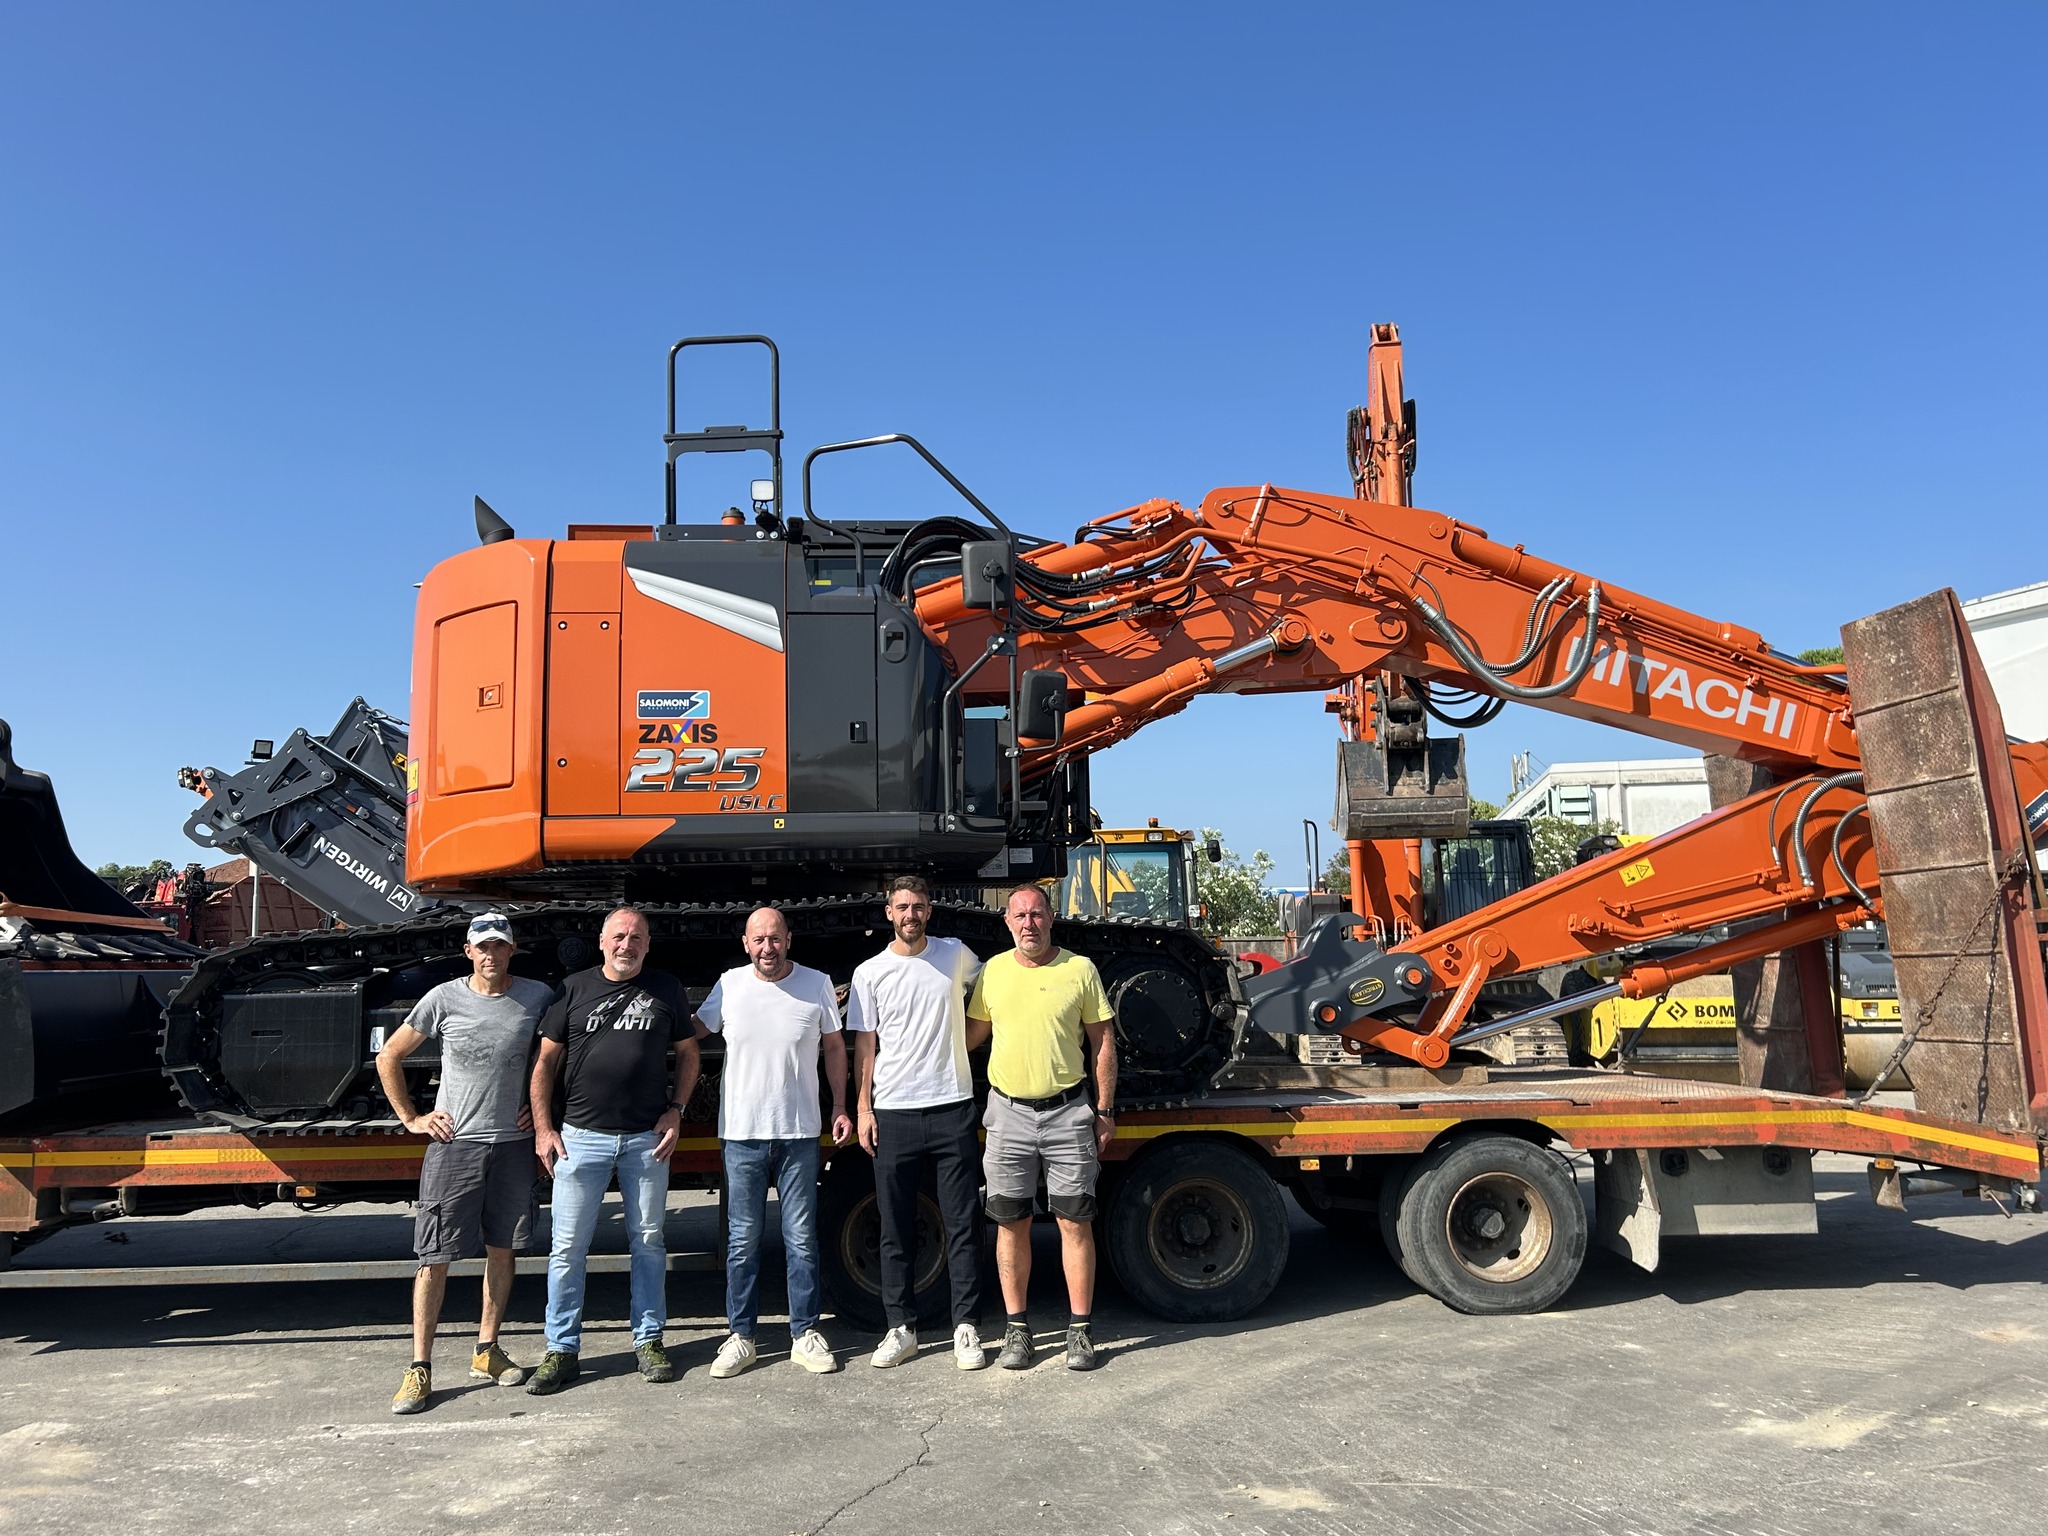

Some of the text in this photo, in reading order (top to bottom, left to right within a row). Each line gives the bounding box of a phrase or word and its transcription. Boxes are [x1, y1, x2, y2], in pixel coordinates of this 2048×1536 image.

[1565, 636, 1798, 740] HITACHI
[639, 698, 690, 707] SALOMONI
[638, 719, 718, 744] ZAXIS
[624, 747, 767, 793] 225
[718, 794, 784, 812] USLC
[313, 836, 388, 894] WIRTGEN
[1694, 1005, 1735, 1018] BOM
